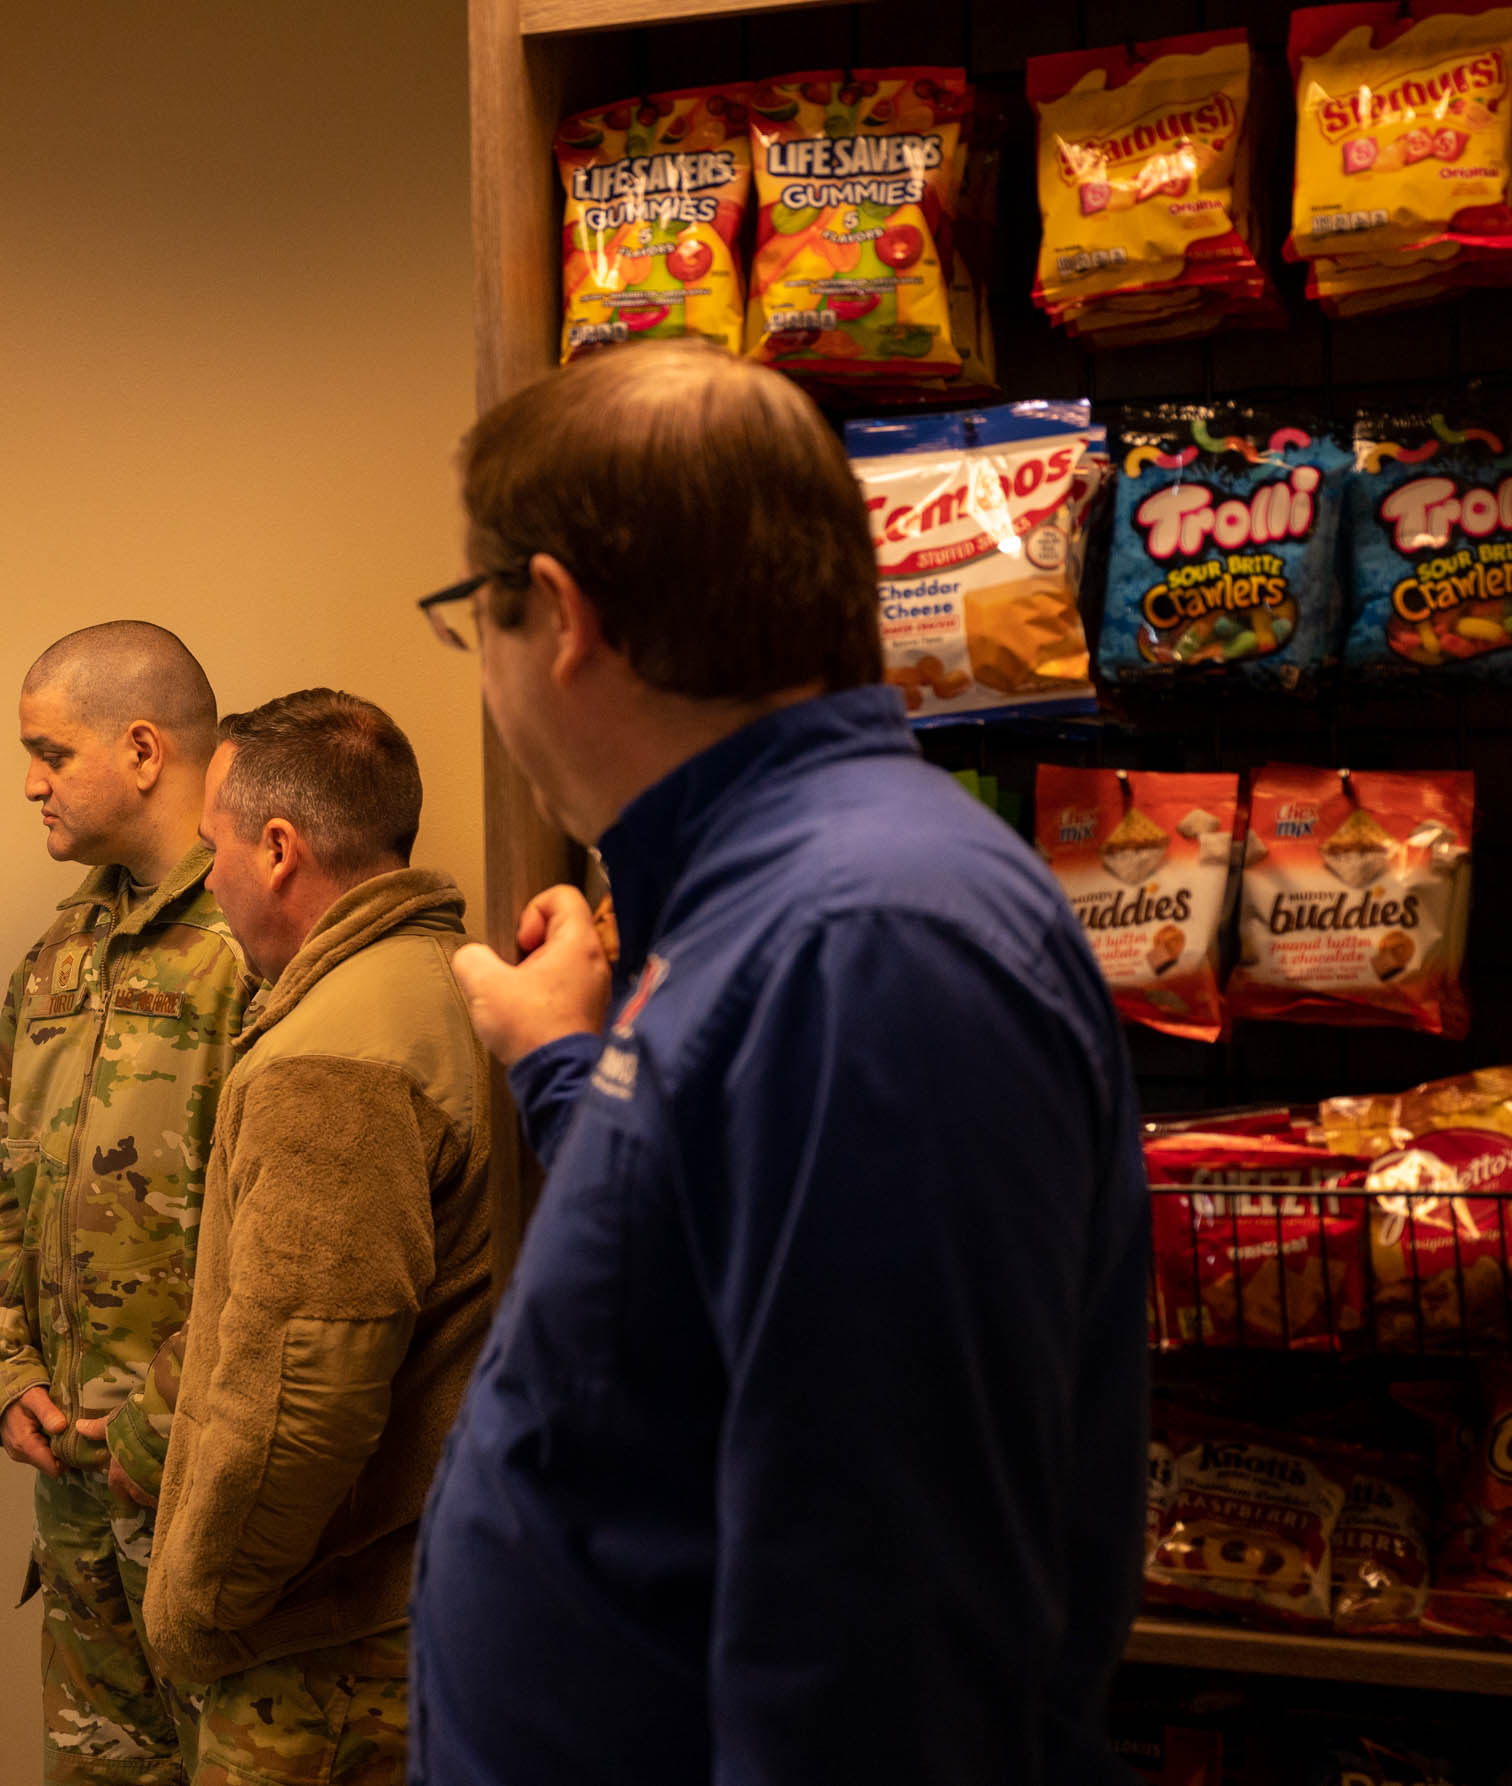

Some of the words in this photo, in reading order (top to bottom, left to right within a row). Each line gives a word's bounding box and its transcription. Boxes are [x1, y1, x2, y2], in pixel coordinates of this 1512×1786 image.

[782, 180, 924, 209] GUMMIES
[586, 198, 717, 231] GUMMIES
[843, 211, 860, 229] 5
[638, 228, 653, 245] 5
[1136, 465, 1322, 559] Trolli
[1167, 559, 1221, 590] SOUR
[1226, 554, 1286, 577] BRITE
[1416, 549, 1472, 584] SOUR
[878, 579, 961, 602] Cheddar
[1142, 575, 1287, 629] Crawlers
[884, 601, 954, 620] Cheese
[1076, 885, 1192, 931] uddies
[1270, 886, 1420, 934] buddies
[1179, 1492, 1311, 1529] RASPBERRY
